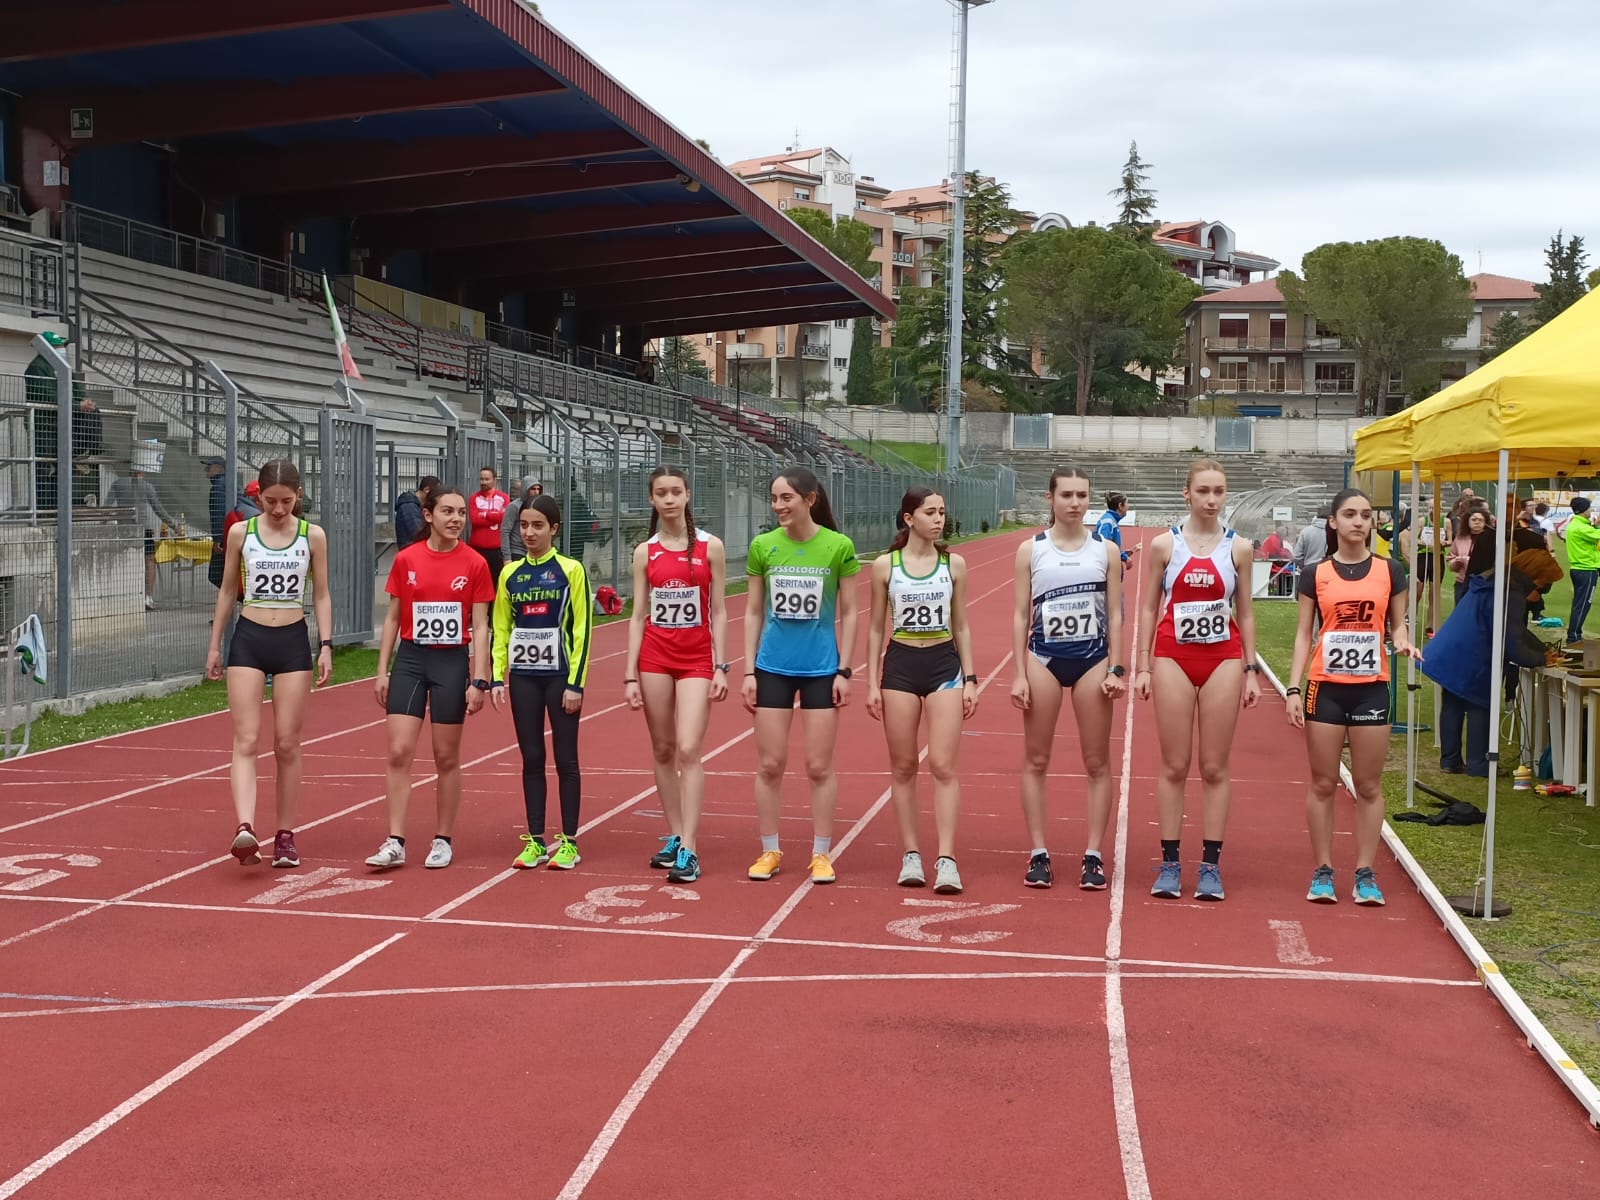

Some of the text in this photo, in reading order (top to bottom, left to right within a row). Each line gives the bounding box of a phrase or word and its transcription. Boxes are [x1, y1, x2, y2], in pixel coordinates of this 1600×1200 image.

[255, 561, 300, 570] SERITAMP
[255, 574, 299, 594] 282
[775, 579, 818, 589] SERITAMP
[511, 589, 561, 603] FANTINI
[655, 590, 695, 600] SERITAMP
[774, 592, 818, 614] 296
[901, 592, 945, 603] SERITAMP
[417, 605, 458, 615] SERITAMP
[655, 603, 697, 623] 279
[902, 605, 944, 627] 281
[1048, 601, 1090, 613] SERITAMP
[1180, 602, 1225, 614] SERITAMP
[416, 618, 459, 639] 299
[514, 631, 554, 640] SERITAMP
[1048, 614, 1092, 637] 297
[1180, 615, 1225, 639] 288
[1329, 635, 1376, 644] SERITAMP
[513, 644, 554, 664] 294
[1328, 648, 1376, 669] 284
[246, 866, 393, 905] 4
[564, 884, 700, 923] 3
[886, 898, 1022, 944] 2
